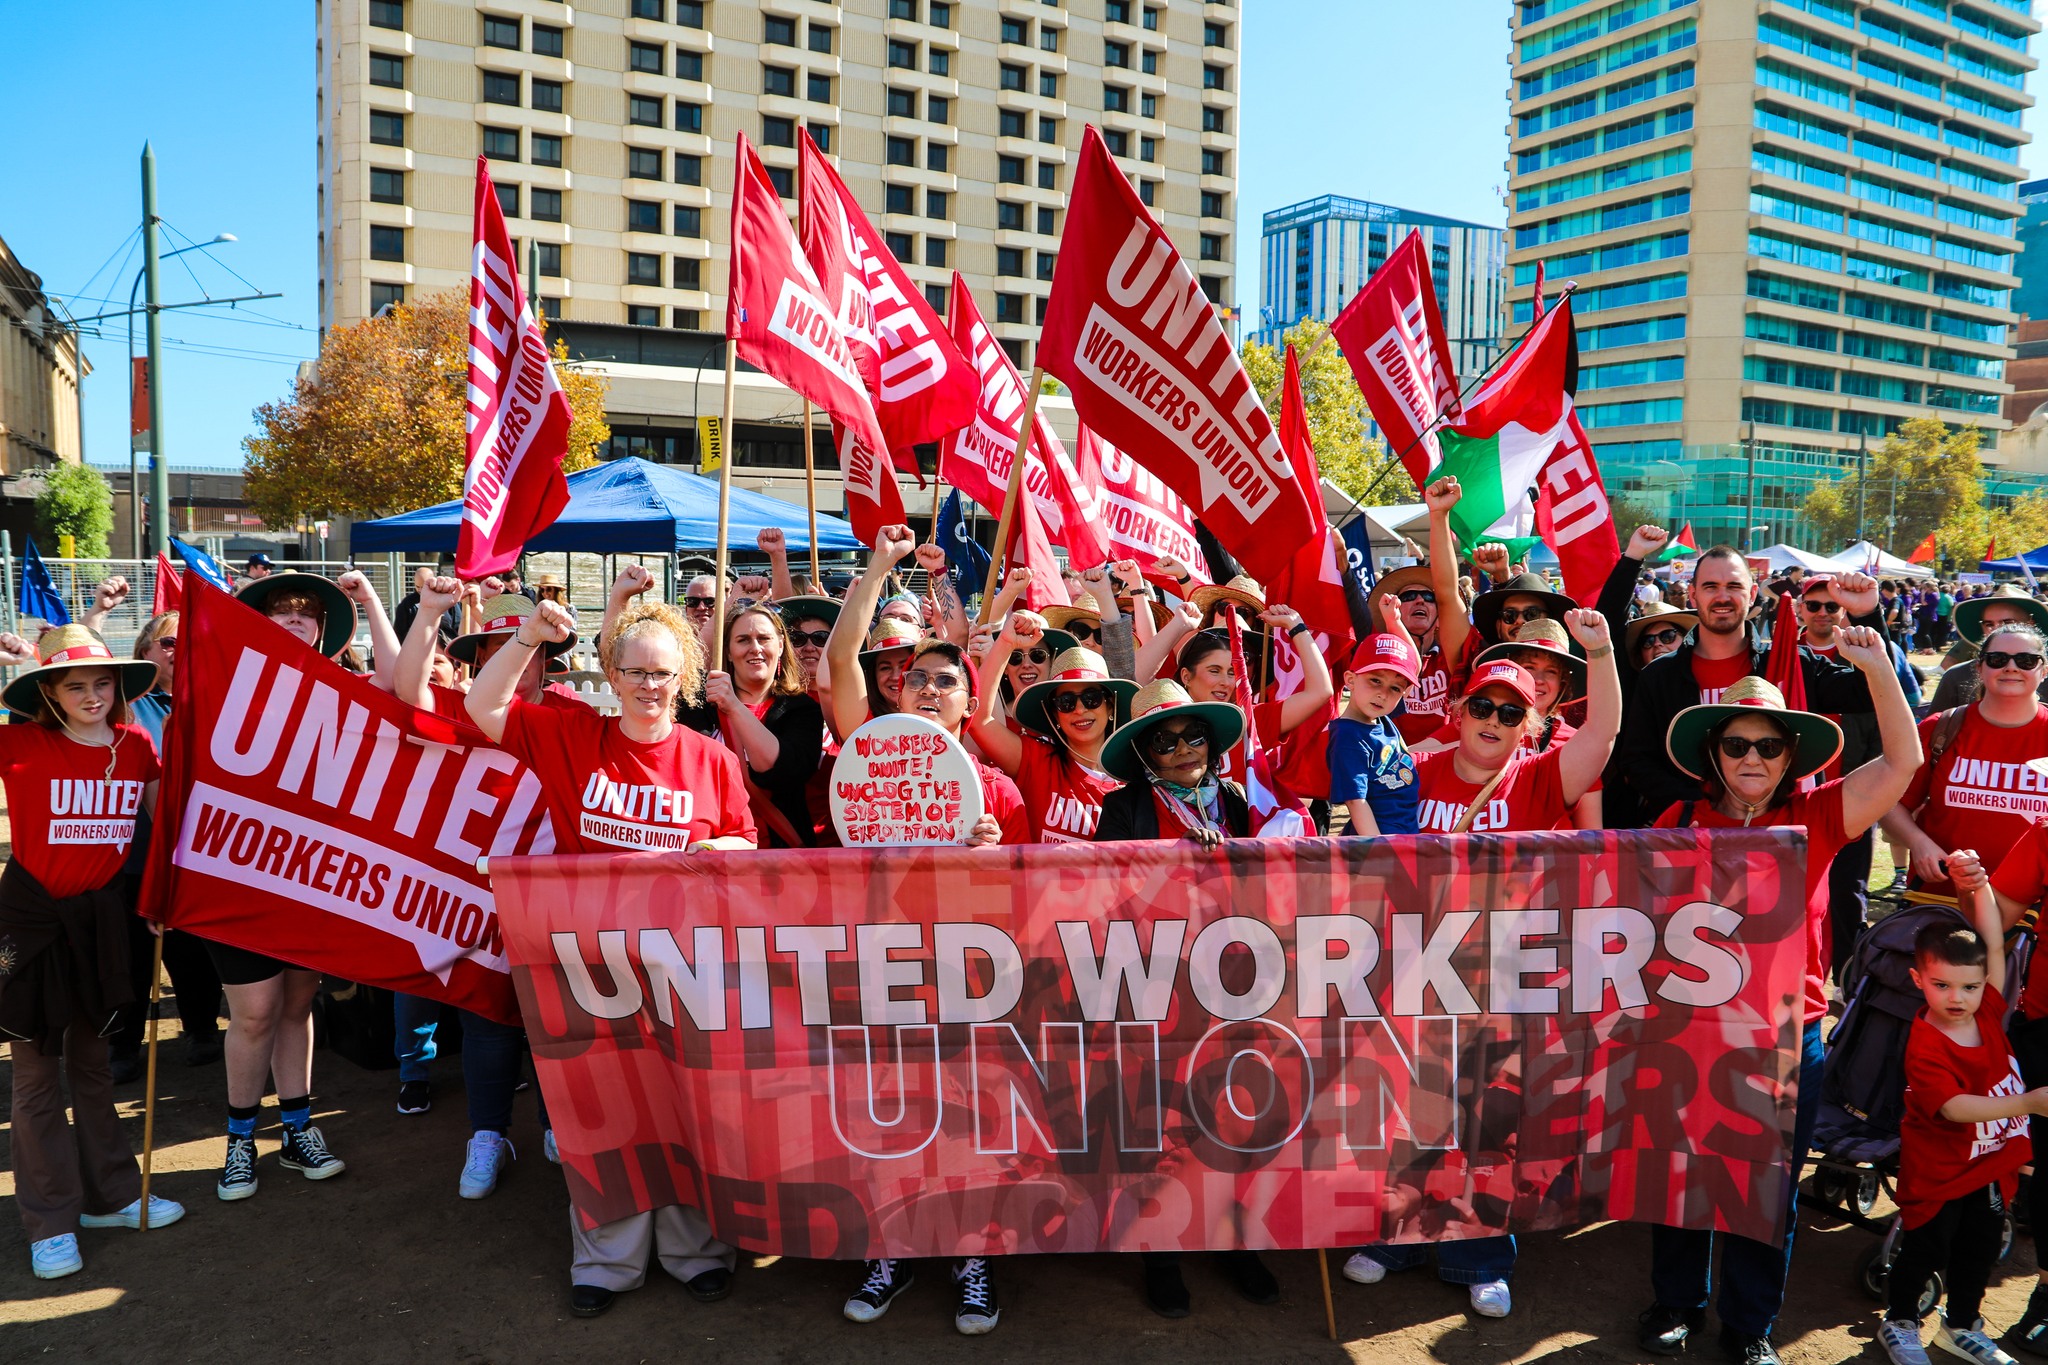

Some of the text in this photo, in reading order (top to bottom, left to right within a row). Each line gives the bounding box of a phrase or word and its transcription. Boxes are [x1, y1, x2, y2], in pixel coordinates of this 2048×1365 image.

[1083, 320, 1270, 508] WORKERS UNION
[463, 396, 532, 521] WORKERS
[1101, 498, 1191, 563] WORKERS
[837, 780, 962, 802] UNCLOG THE
[868, 756, 933, 780] UNITE!
[582, 773, 694, 824] UNITED
[843, 801, 961, 823] SYSTEM OF
[1949, 790, 2008, 809] WORKERS
[54, 824, 109, 840] WORKERS
[191, 803, 391, 910] WORKERS
[583, 818, 685, 849] WORKERS UNION
[549, 901, 1746, 1032] UNITED WORKERS
[827, 1014, 1460, 1160] UNION
